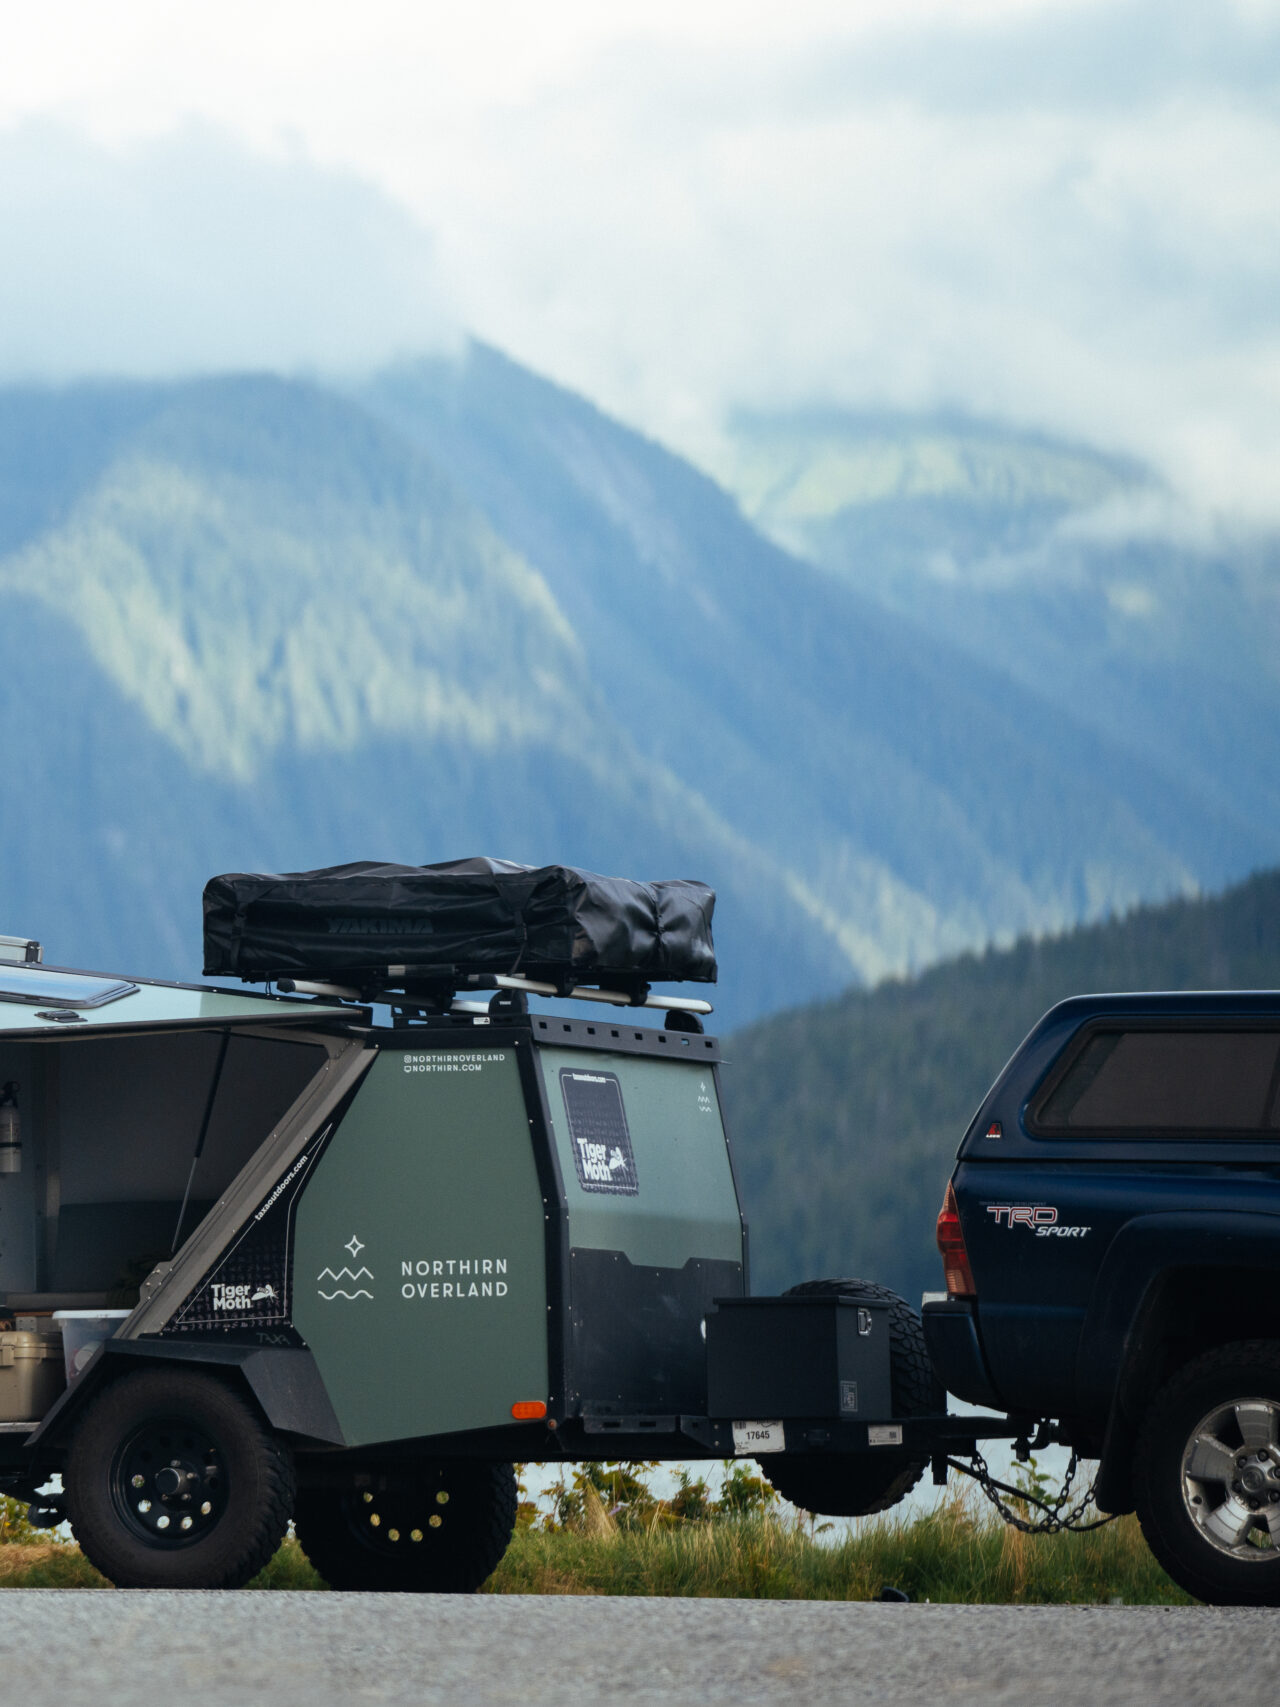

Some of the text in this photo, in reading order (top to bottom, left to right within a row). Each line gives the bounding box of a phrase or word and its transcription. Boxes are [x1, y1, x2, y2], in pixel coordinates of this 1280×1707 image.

[327, 918, 434, 934] YAKIMA
[412, 1054, 505, 1063] NORTHIRNOVERLAND
[412, 1064, 482, 1073] NORTHIRN.COM
[576, 1138, 607, 1164] Tiger
[581, 1159, 613, 1181] Moth
[254, 1155, 309, 1221] taxaoutdoors.com
[986, 1206, 1058, 1229] TRD
[1035, 1226, 1089, 1237] SPORT
[401, 1259, 507, 1276] NORTHIRN
[210, 1283, 251, 1299] Tiger
[401, 1281, 508, 1299] OVERLAND
[213, 1295, 252, 1311] Moth
[746, 1430, 770, 1440] 17645
